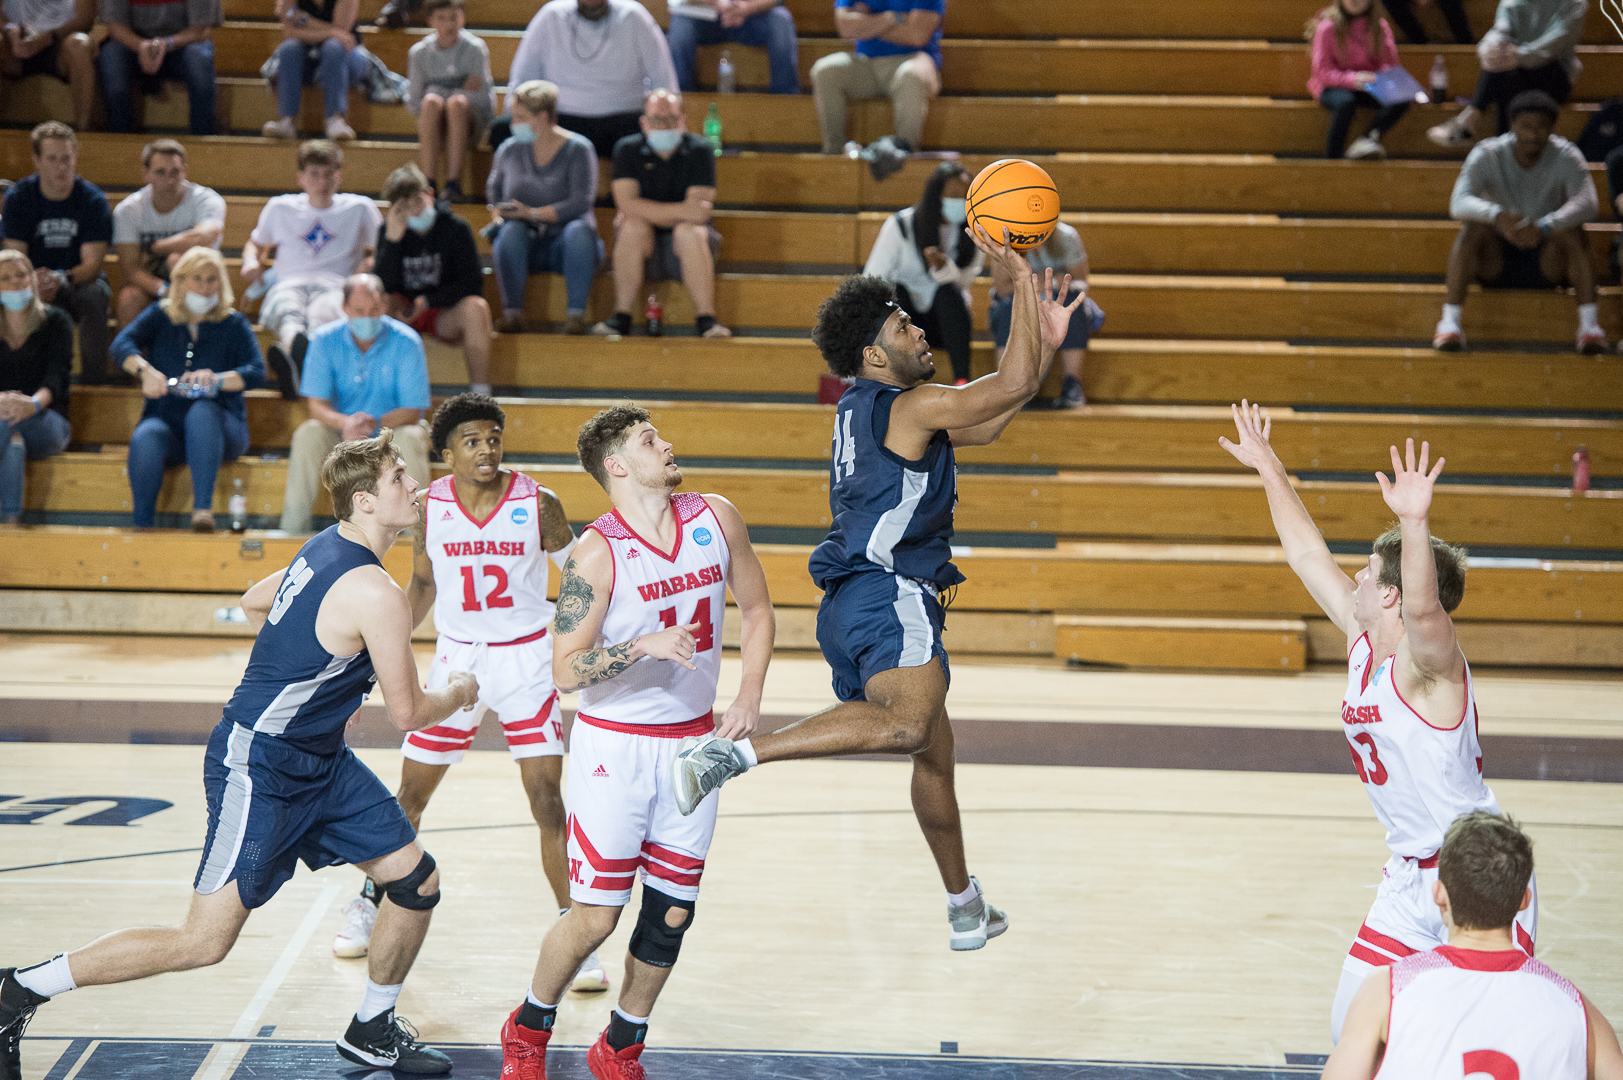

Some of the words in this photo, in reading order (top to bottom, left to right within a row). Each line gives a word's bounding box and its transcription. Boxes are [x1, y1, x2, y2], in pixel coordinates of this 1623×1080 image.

[443, 541, 525, 557] WABASH
[460, 564, 514, 612] 12
[637, 563, 723, 602] WABASH
